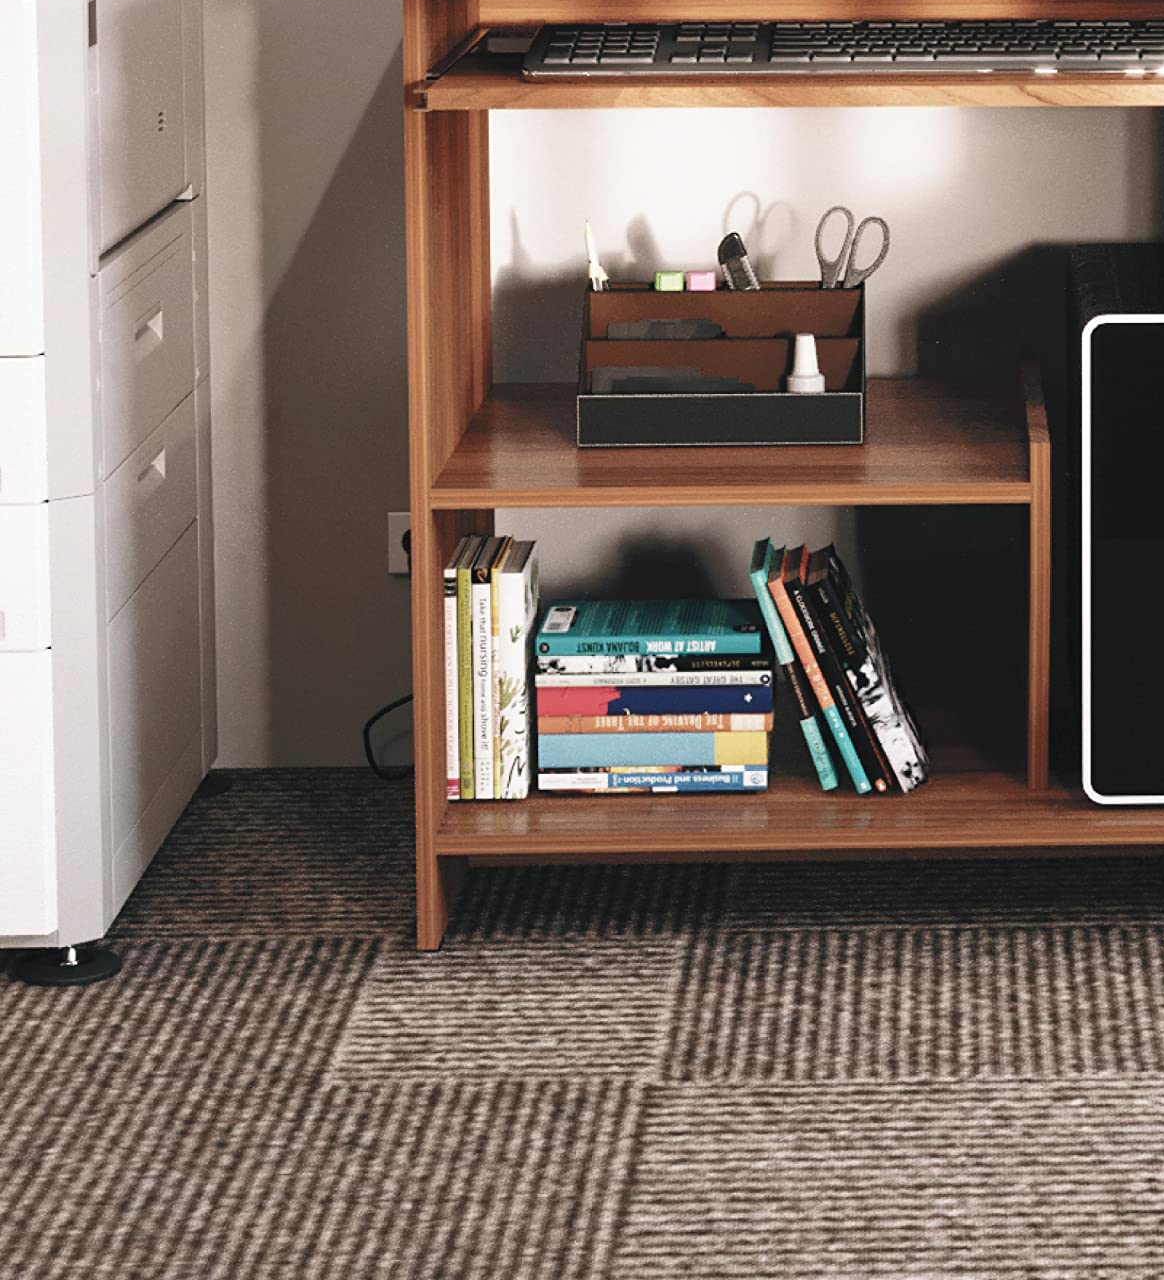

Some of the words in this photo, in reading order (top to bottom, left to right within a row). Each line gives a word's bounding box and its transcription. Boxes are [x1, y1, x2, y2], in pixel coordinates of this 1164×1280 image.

[479, 598, 487, 616] Take
[479, 617, 487, 635] that
[796, 596, 815, 630] CLOCKWORK
[810, 629, 827, 655] ORANGE
[576, 642, 604, 654] KUNST
[606, 641, 640, 653] BOJANA
[646, 640, 673, 653] WORK
[674, 640, 685, 653] AT
[686, 640, 717, 653] ARTIST
[478, 635, 488, 677] nursing
[670, 675, 701, 685] GATSBY
[703, 674, 727, 684] GREAT
[729, 674, 743, 683] THE
[480, 713, 489, 740] shove
[594, 715, 625, 731] THREE
[648, 714, 660, 726] OF
[662, 714, 702, 729] DRAWING
[706, 713, 724, 729] THE
[623, 774, 672, 785] Production
[674, 774, 690, 784] and
[693, 774, 731, 784] Business
